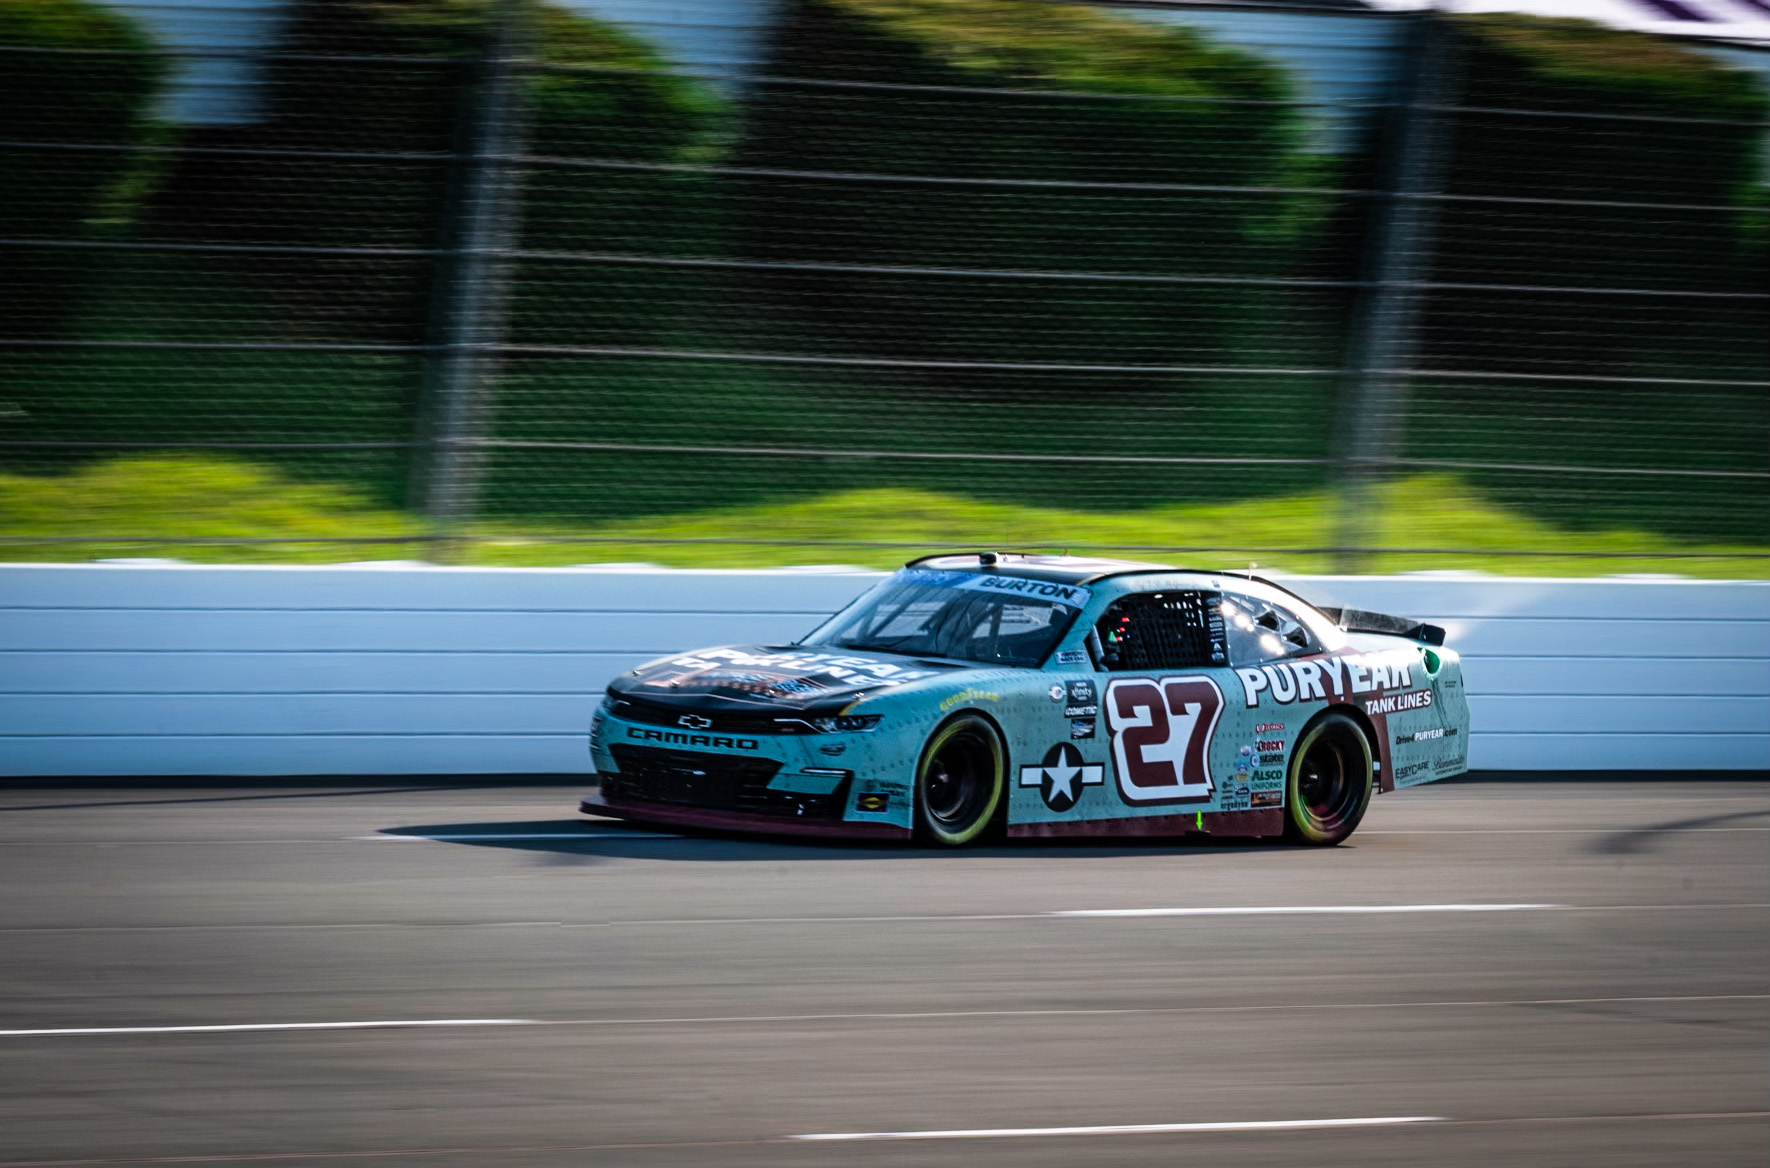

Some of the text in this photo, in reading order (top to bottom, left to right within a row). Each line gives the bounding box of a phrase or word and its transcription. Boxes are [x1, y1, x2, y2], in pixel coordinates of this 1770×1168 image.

[980, 577, 1077, 600] BURTON
[1365, 690, 1432, 714] TANK LINES
[627, 727, 758, 750] CAMARO
[1108, 677, 1222, 801] 27
[1251, 770, 1283, 781] ALSCO
